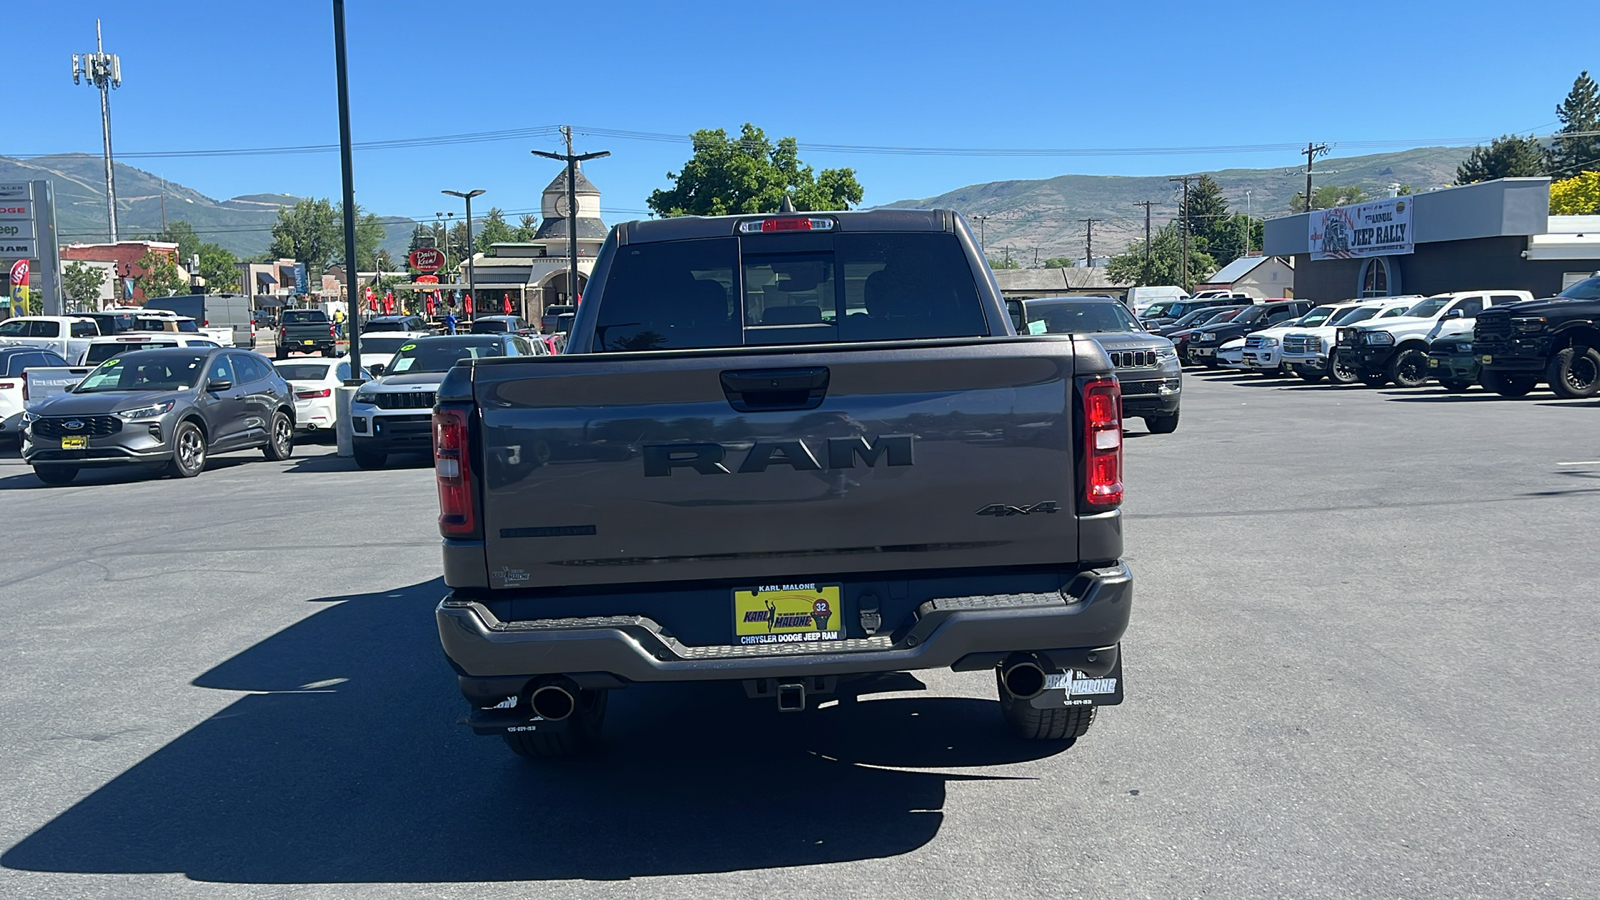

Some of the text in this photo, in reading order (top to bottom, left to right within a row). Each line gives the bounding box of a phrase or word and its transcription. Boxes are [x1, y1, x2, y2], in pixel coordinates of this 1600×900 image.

[1372, 212, 1393, 224] ANNUAL
[1351, 223, 1407, 247] JEEP RALLY
[415, 250, 438, 263] Dairy
[417, 257, 434, 266] Keen
[11, 263, 28, 284] USED
[642, 433, 915, 478] RAM
[782, 583, 816, 591] MALONE
[815, 603, 827, 612] 32
[743, 610, 813, 629] KARL MALONE
[740, 631, 838, 645] CHRYSLER DODGE JEEP RAM
[1043, 674, 1068, 690] ARL
[1071, 679, 1117, 695] MALONE
